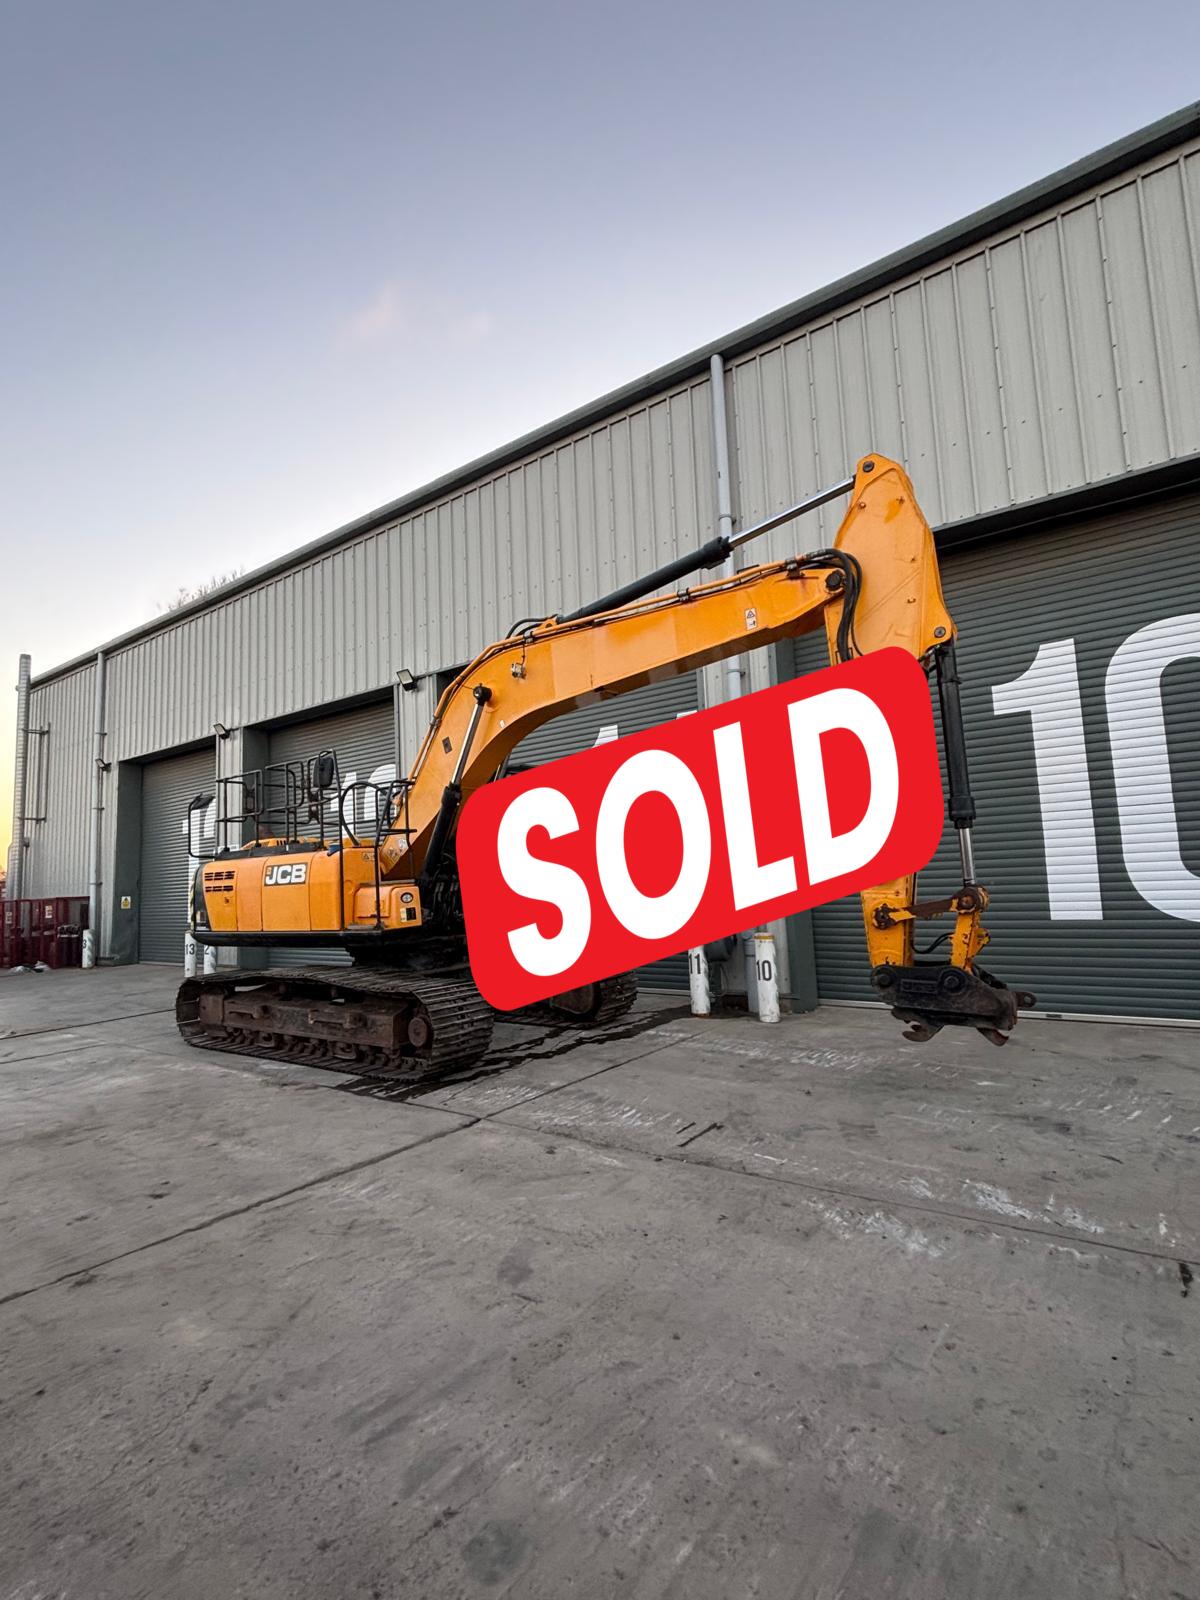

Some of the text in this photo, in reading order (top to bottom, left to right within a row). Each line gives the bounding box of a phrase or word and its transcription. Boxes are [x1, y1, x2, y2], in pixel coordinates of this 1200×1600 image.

[265, 863, 307, 885] JCB
[185, 943, 195, 955] 13
[688, 953, 701, 975] 11
[756, 960, 772, 981] 10
